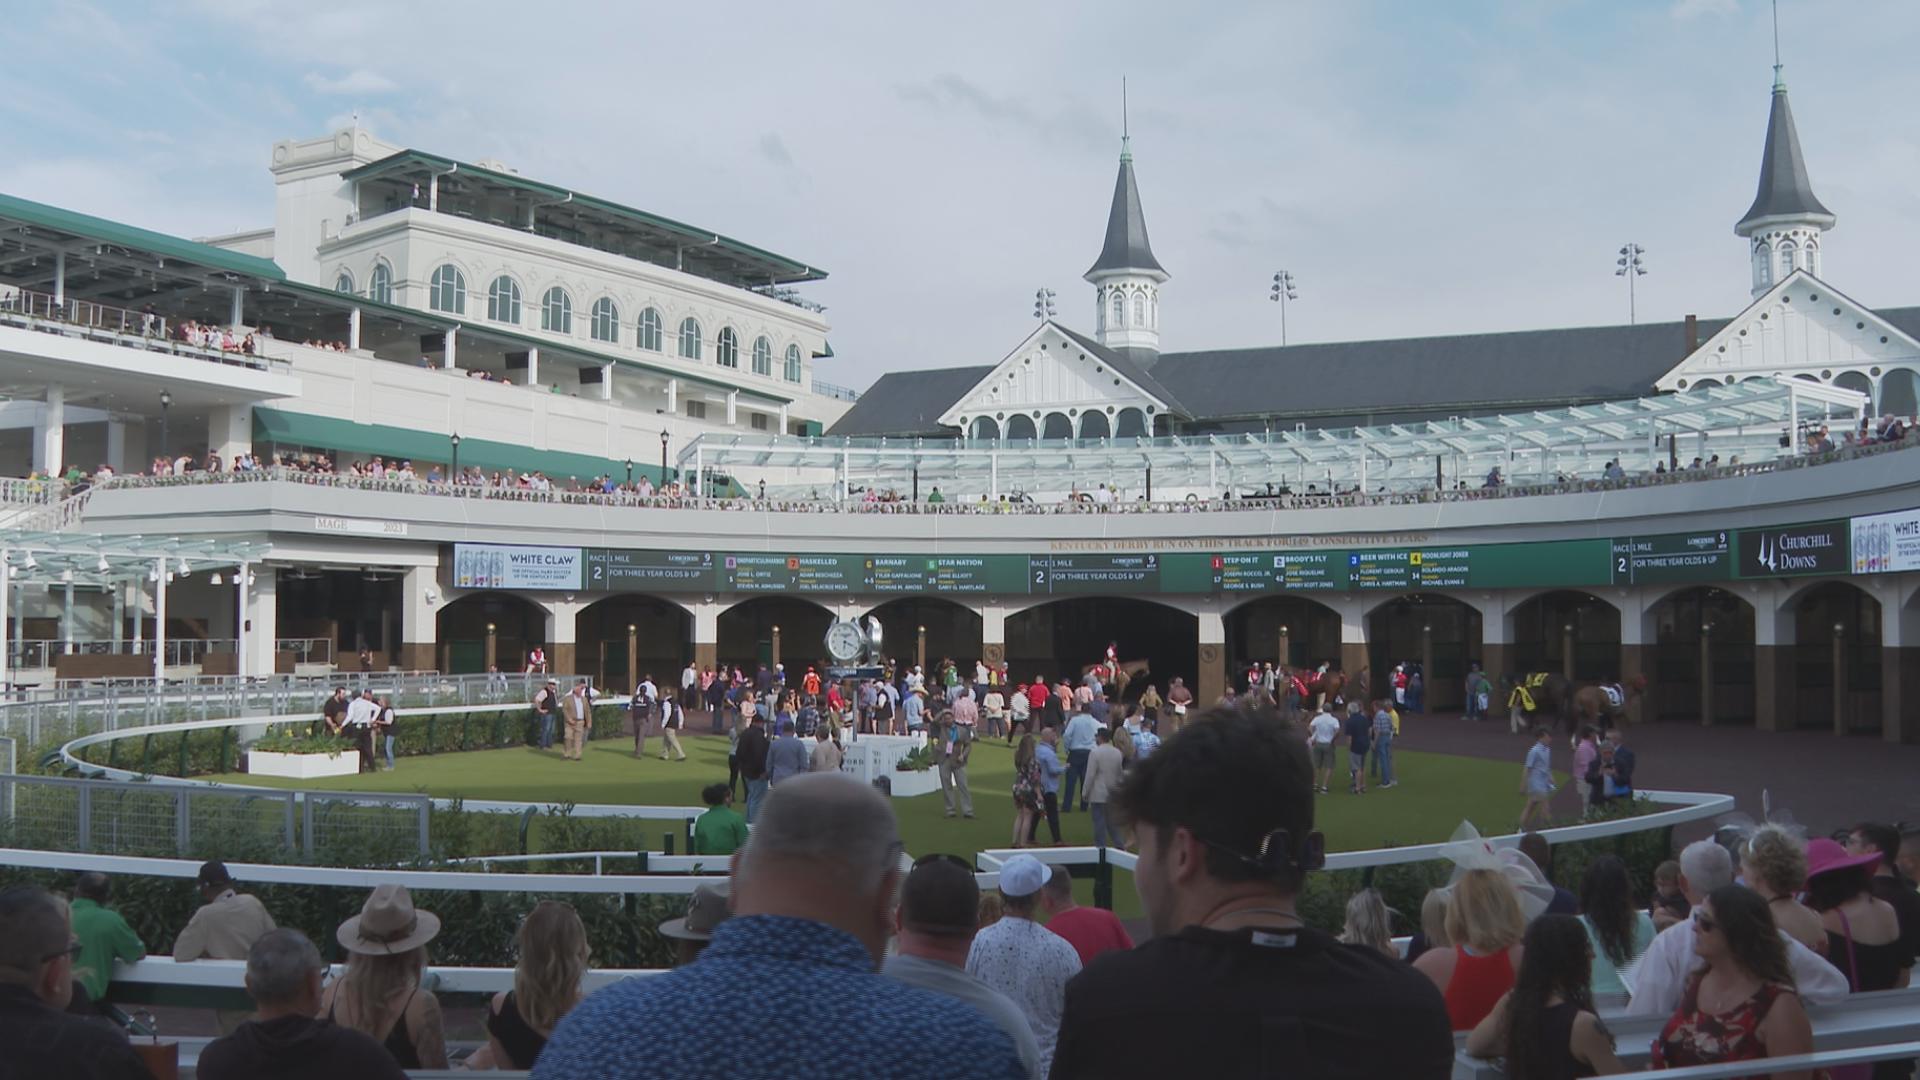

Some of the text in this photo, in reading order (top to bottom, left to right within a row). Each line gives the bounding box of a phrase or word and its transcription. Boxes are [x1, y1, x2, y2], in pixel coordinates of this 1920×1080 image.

[318, 518, 348, 530] MAGE
[1894, 521, 1920, 535] WHITE
[1052, 540, 1108, 550] KENTUCKY
[1114, 539, 1149, 550] DERBY
[1153, 539, 1176, 549] RUN
[1178, 538, 1194, 548] ON
[1200, 538, 1224, 548] THIS
[1228, 538, 1264, 548] TRACK
[1267, 538, 1289, 546] FOR
[1312, 535, 1387, 546] CONSECUTIVE
[1391, 534, 1428, 544] YEARS
[1720, 532, 1726, 543] 9
[1779, 534, 1832, 550] CHURCHILL
[1614, 544, 1630, 552] RACE
[510, 554, 574, 565] WHITE CLAW
[590, 554, 606, 562] RACE
[704, 552, 710, 562] 9
[800, 558, 838, 566] HASKELLED
[1148, 555, 1155, 564] 9
[1352, 556, 1357, 564] 3
[1634, 560, 1646, 568] FOR
[1648, 558, 1666, 567] THREE
[1668, 558, 1683, 566] YEAR
[1684, 557, 1701, 565] OLDS
[1780, 554, 1816, 569] DOWNS
[1618, 558, 1626, 572] 2
[594, 566, 602, 580] 2
[1036, 571, 1044, 583] 2
